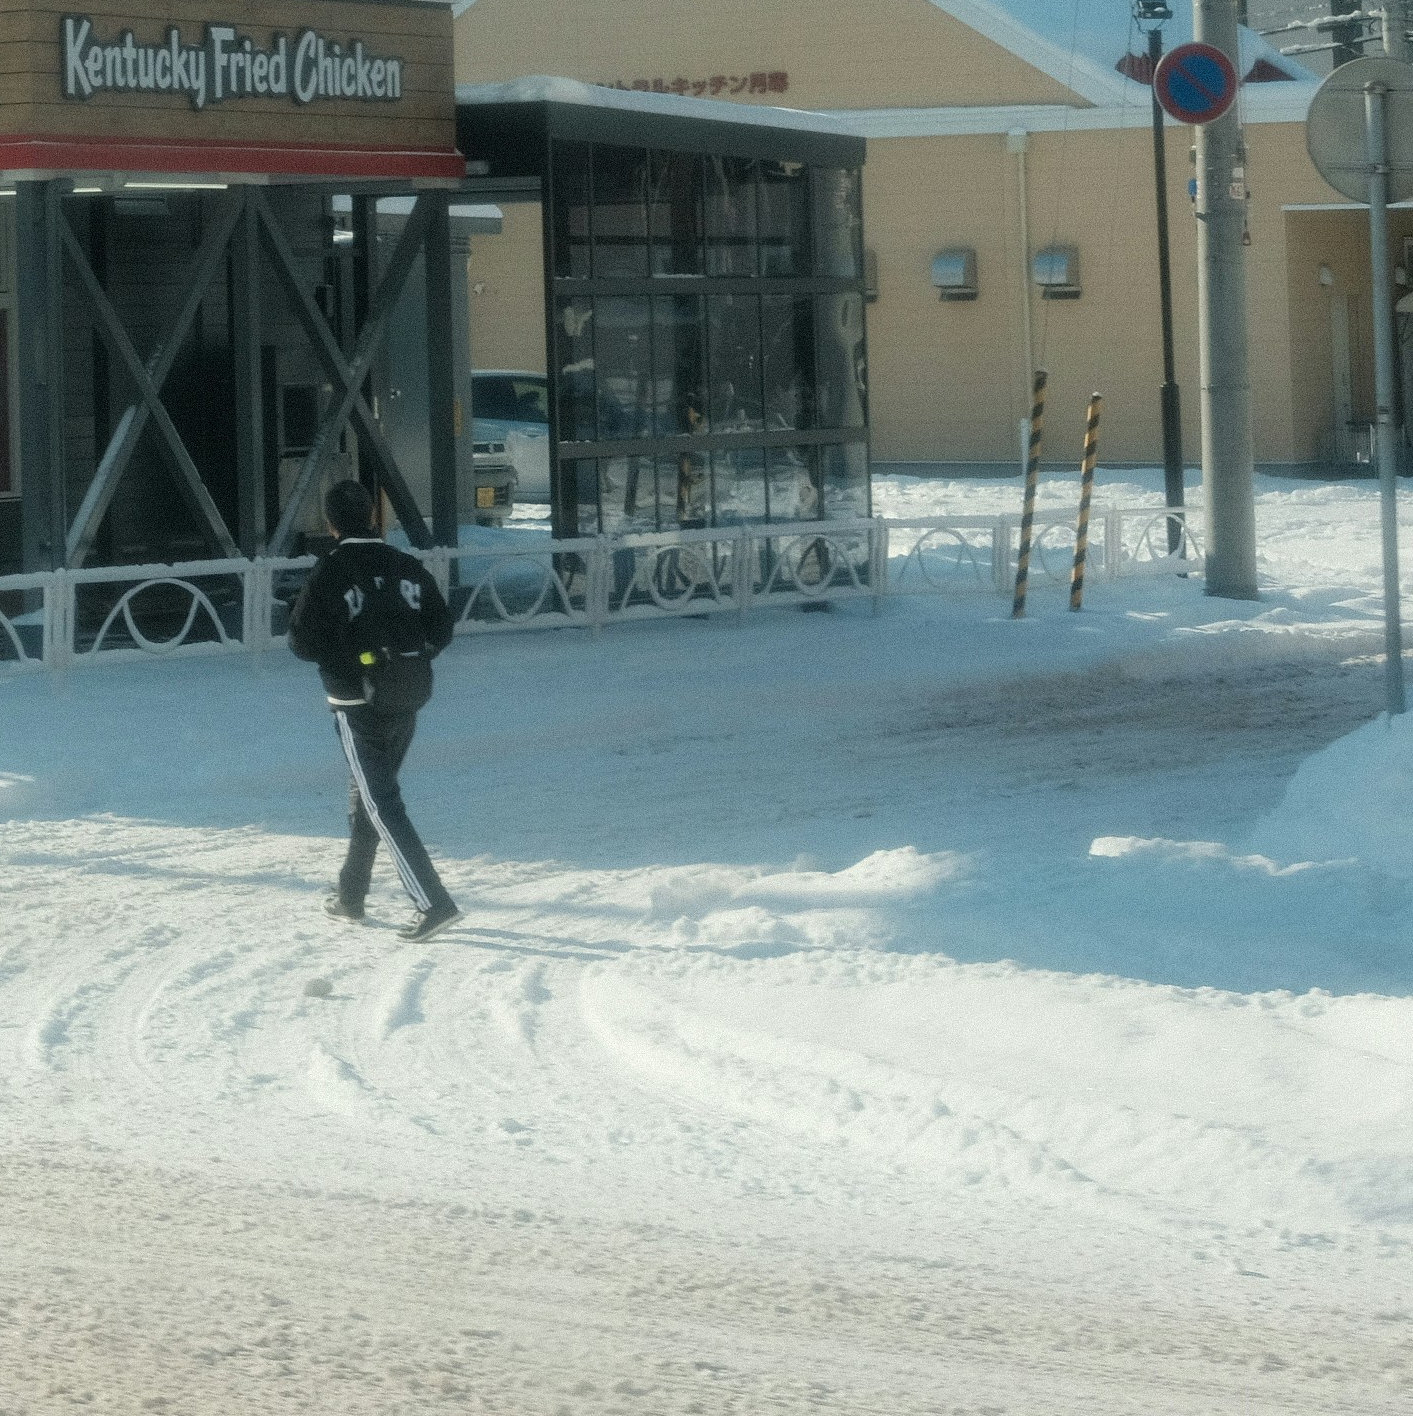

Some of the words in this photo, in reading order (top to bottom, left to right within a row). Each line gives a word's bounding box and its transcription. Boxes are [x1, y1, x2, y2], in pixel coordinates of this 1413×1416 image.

[65, 17, 206, 109] Kentucky
[210, 27, 287, 99] Fried
[294, 30, 401, 103] Chicken
